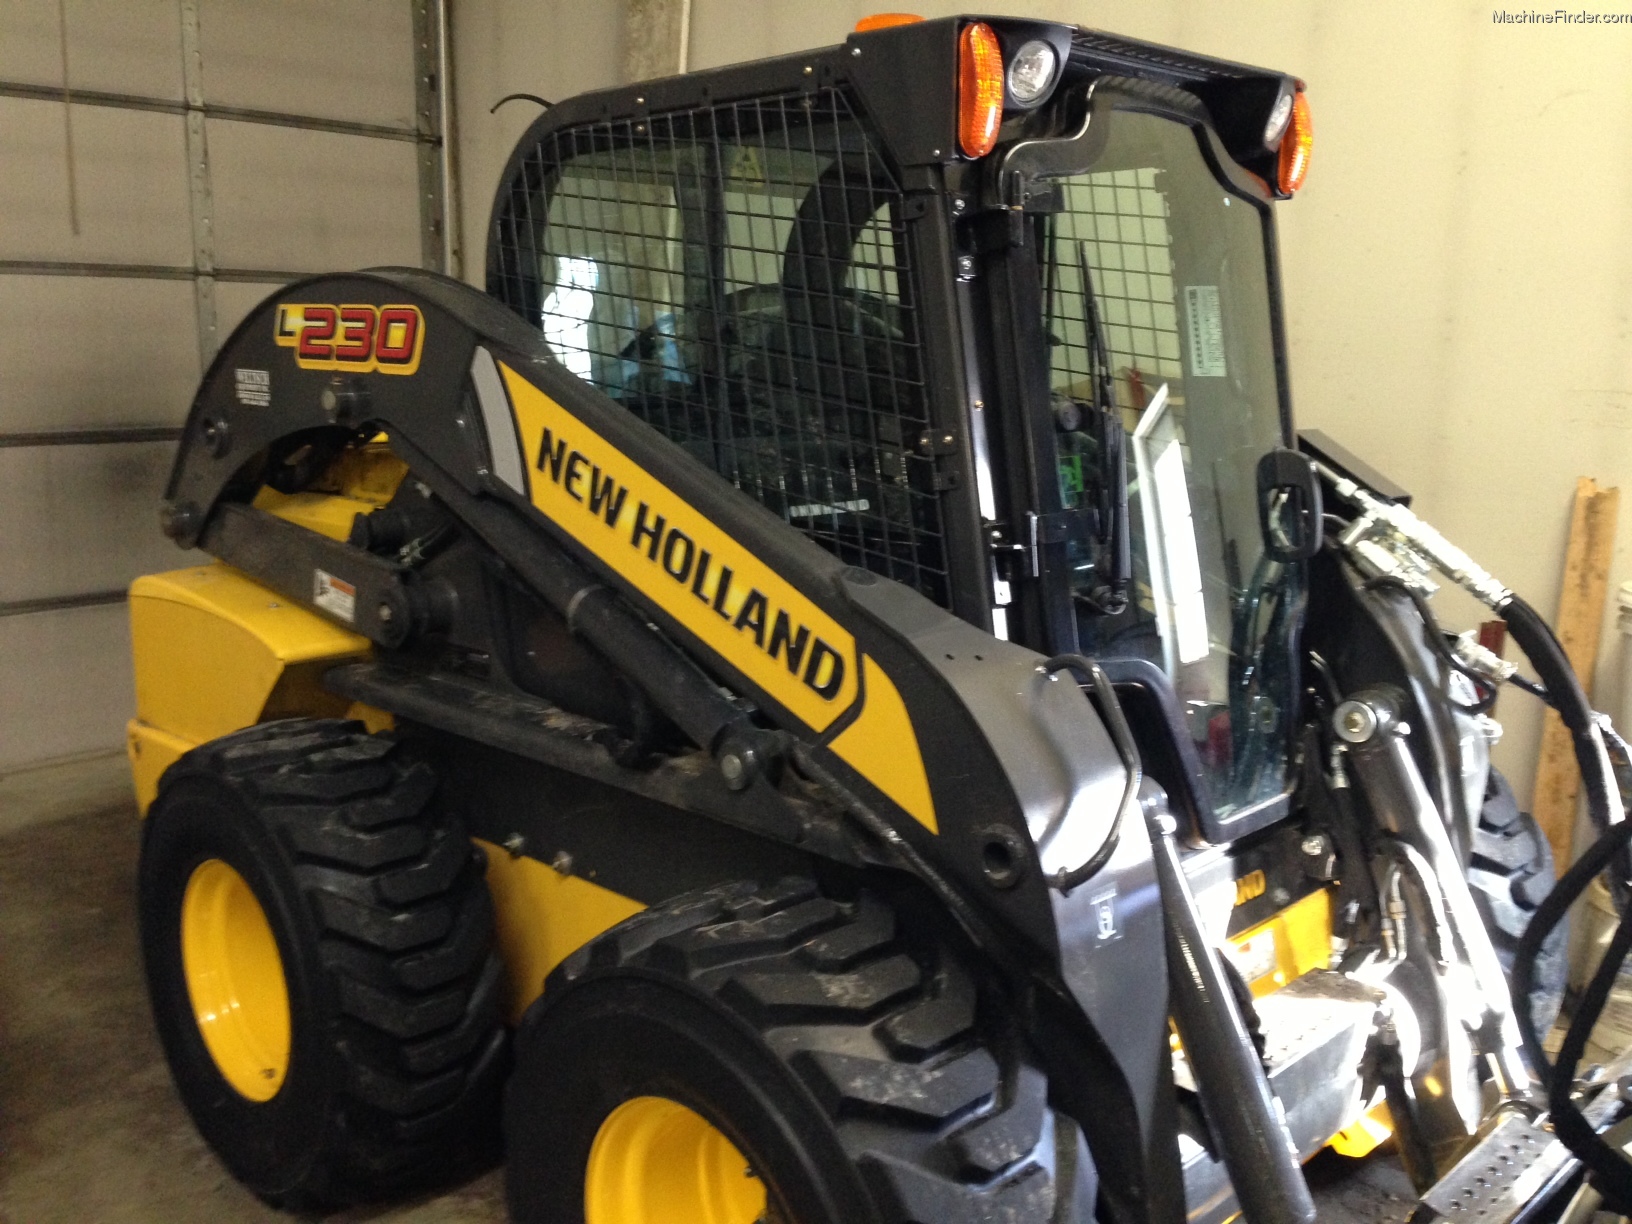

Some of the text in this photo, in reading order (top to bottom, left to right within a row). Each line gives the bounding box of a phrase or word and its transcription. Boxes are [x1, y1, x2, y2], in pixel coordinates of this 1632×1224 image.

[276, 305, 421, 369] L230
[536, 426, 846, 702] NEW HOLLAND
